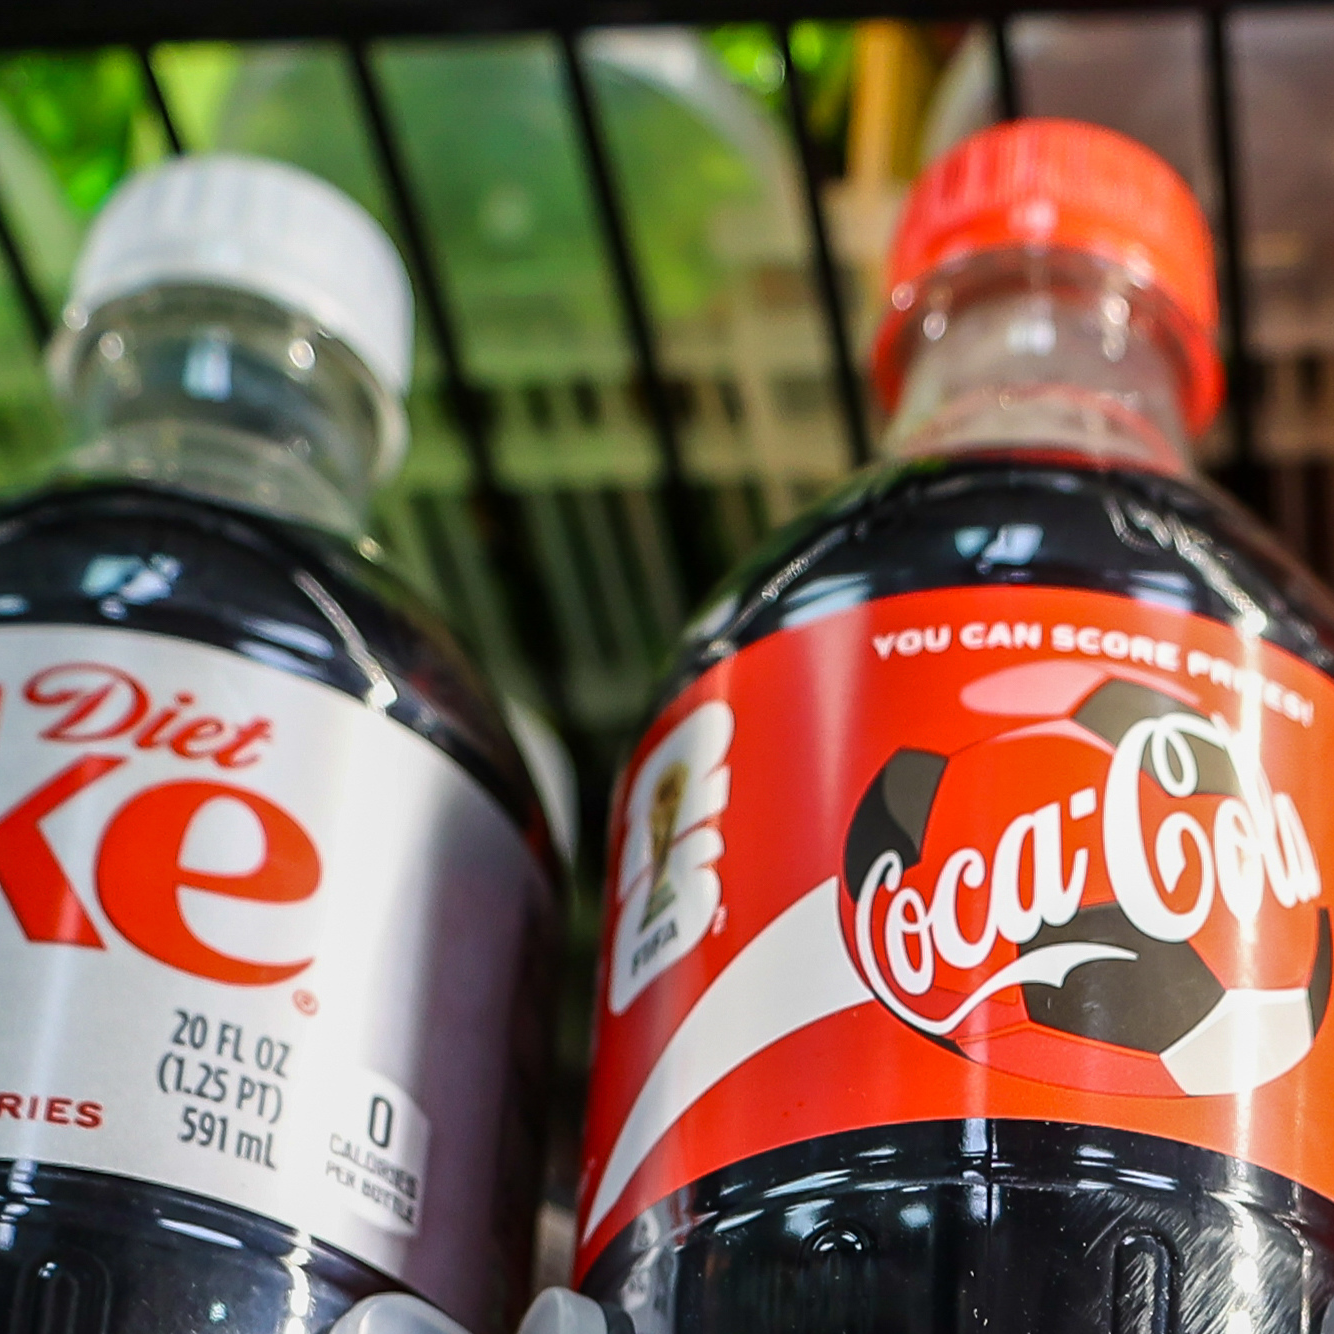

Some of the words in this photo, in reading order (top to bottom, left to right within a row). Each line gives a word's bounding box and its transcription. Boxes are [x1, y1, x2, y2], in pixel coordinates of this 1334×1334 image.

[872, 625, 952, 659] YOU
[959, 622, 1043, 650] CAN
[1051, 623, 1181, 672] SCORE
[22, 661, 272, 770] Diet
[855, 711, 1323, 1036] Coca-Cola
[171, 1008, 208, 1051] 20
[216, 1020, 245, 1064] FL
[254, 1035, 292, 1080] OZ
[156, 1051, 228, 1104] (1.25
[235, 1075, 284, 1125] PT)
[368, 1095, 394, 1150] 0
[177, 1105, 229, 1153] 591
[234, 1129, 278, 1173] mL
[324, 1159, 356, 1190] PER
